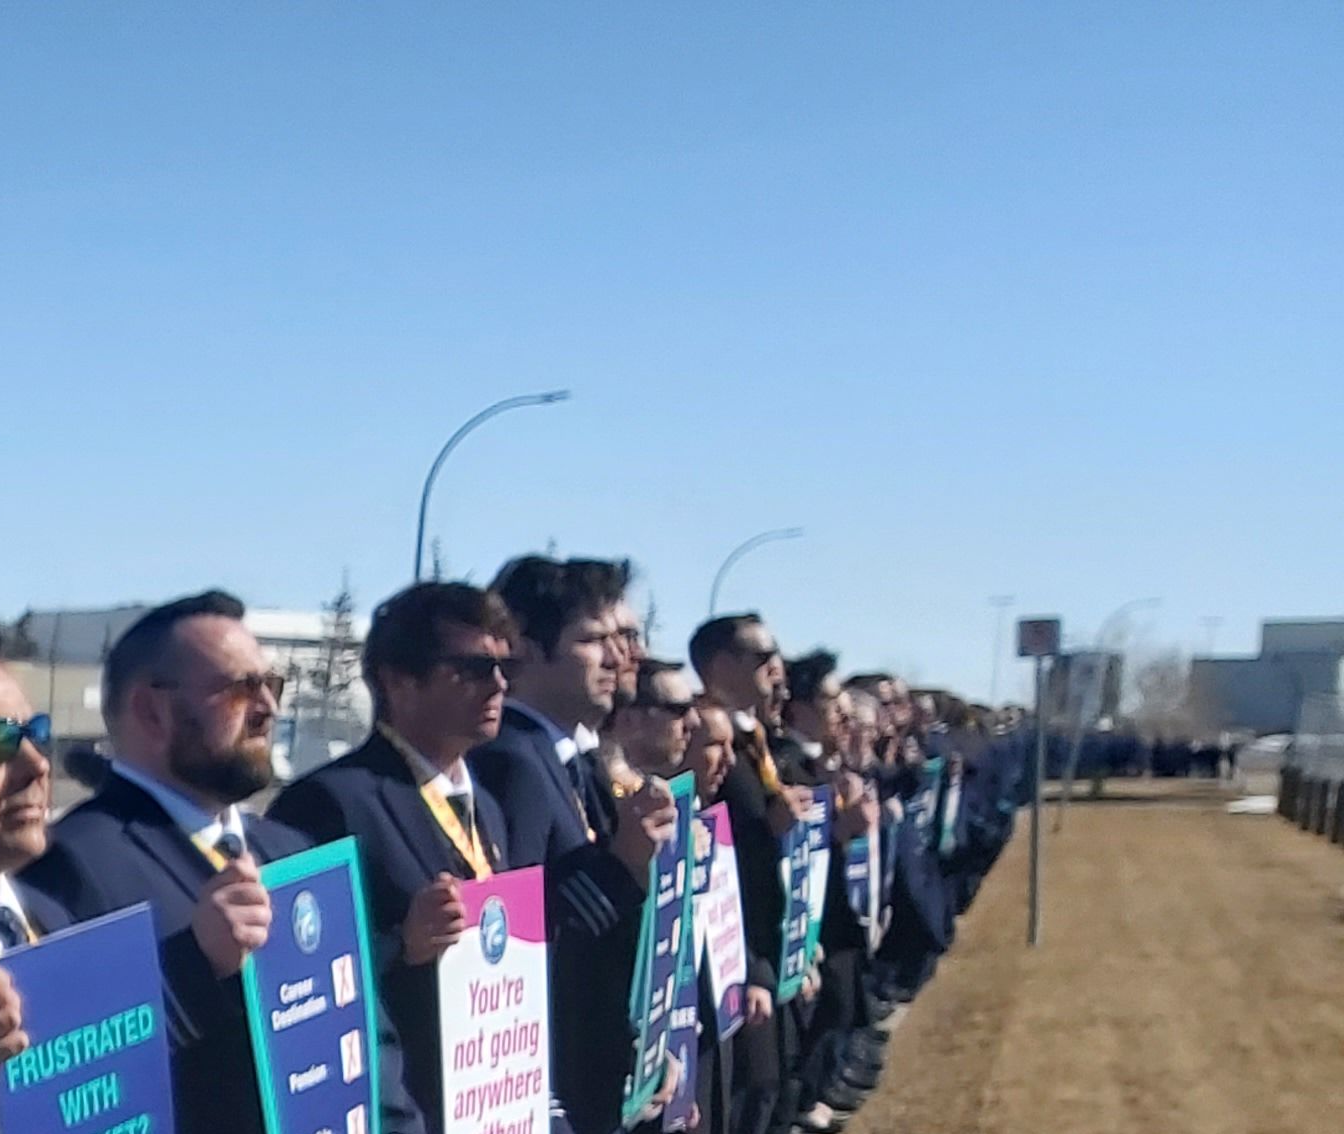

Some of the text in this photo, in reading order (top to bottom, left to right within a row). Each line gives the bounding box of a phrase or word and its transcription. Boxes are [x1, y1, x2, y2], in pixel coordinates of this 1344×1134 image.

[468, 976, 524, 1016] You're
[5, 1003, 155, 1092] FRUSTRATED
[453, 1019, 539, 1072] not going
[58, 1071, 121, 1128] WITH
[453, 1067, 543, 1122] anywhere
